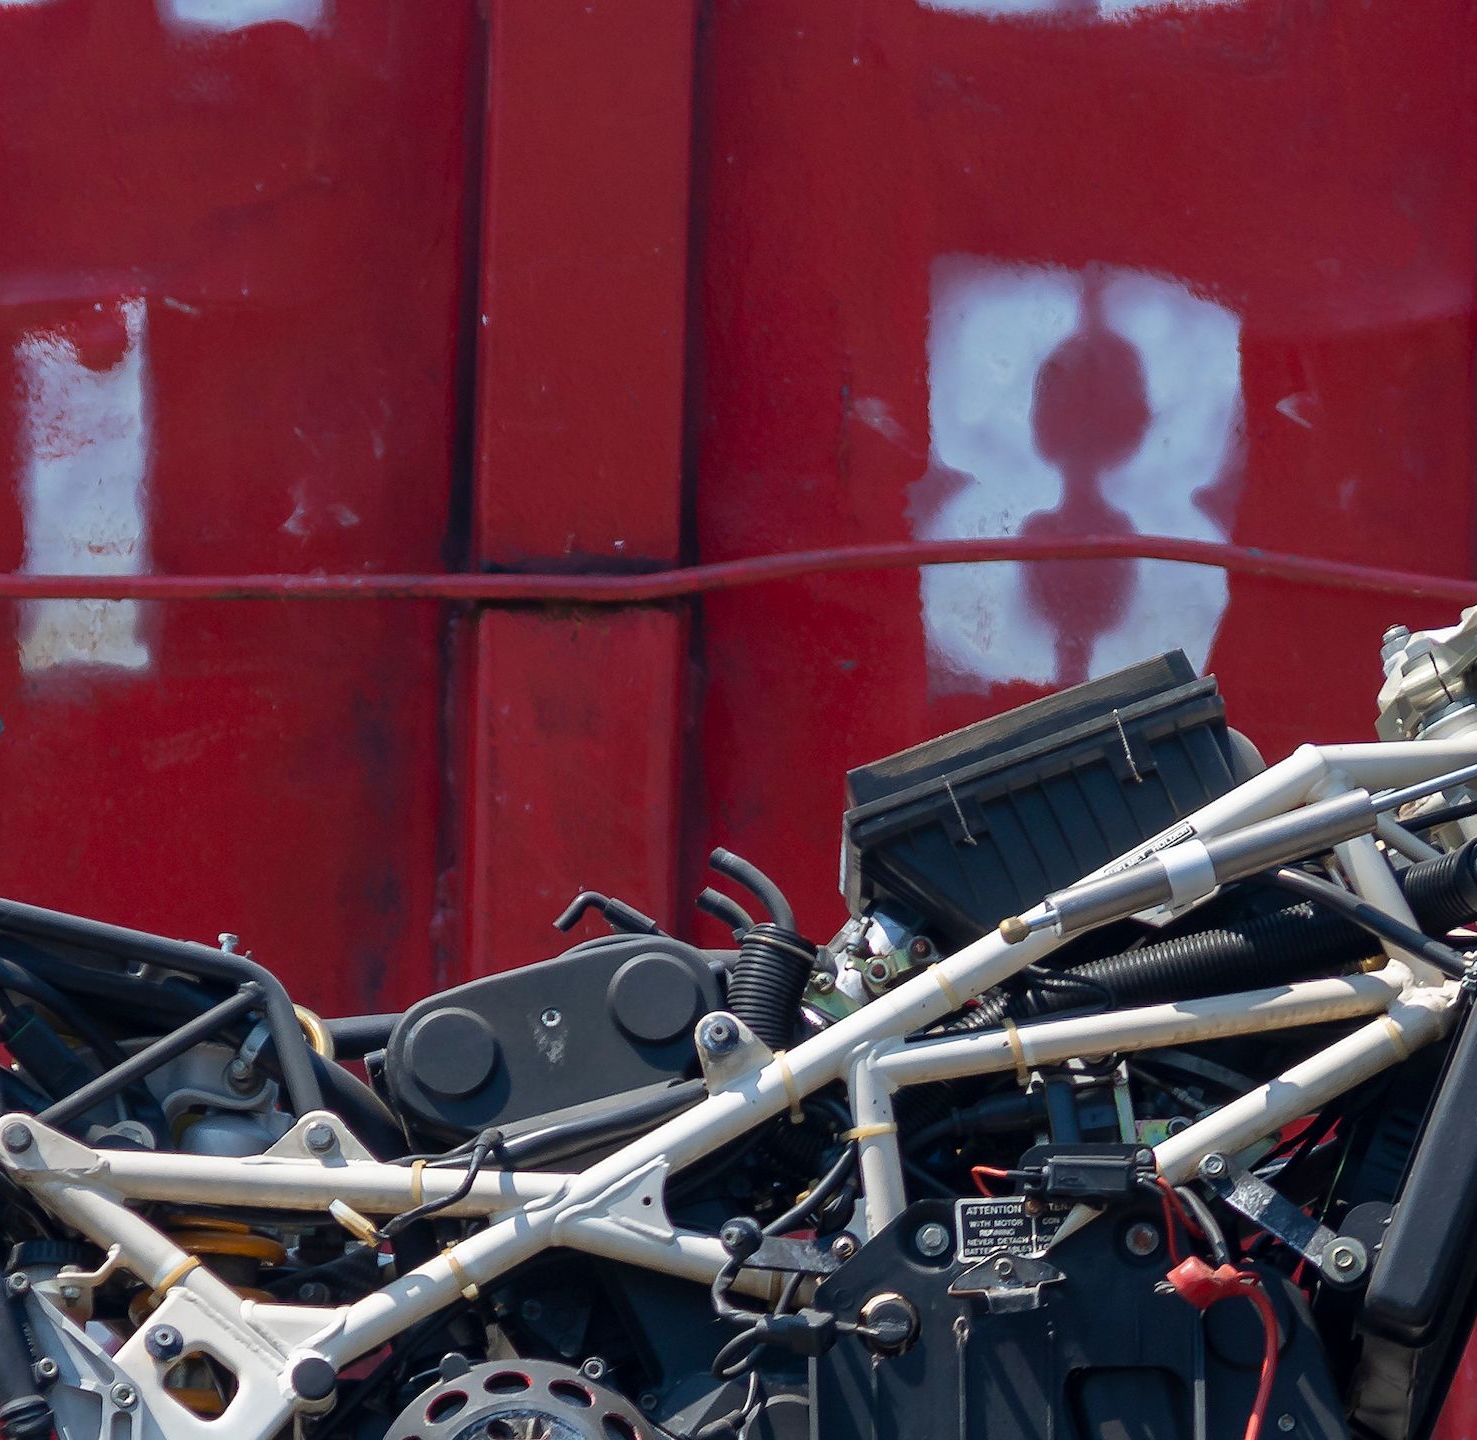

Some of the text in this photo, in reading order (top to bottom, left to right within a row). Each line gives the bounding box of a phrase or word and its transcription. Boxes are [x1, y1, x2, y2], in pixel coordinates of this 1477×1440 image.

[966, 1204, 1023, 1215] ATTENTION
[969, 1218, 1024, 1228] WITH MOTOR
[967, 1236, 1029, 1246] NEVER DETACH
